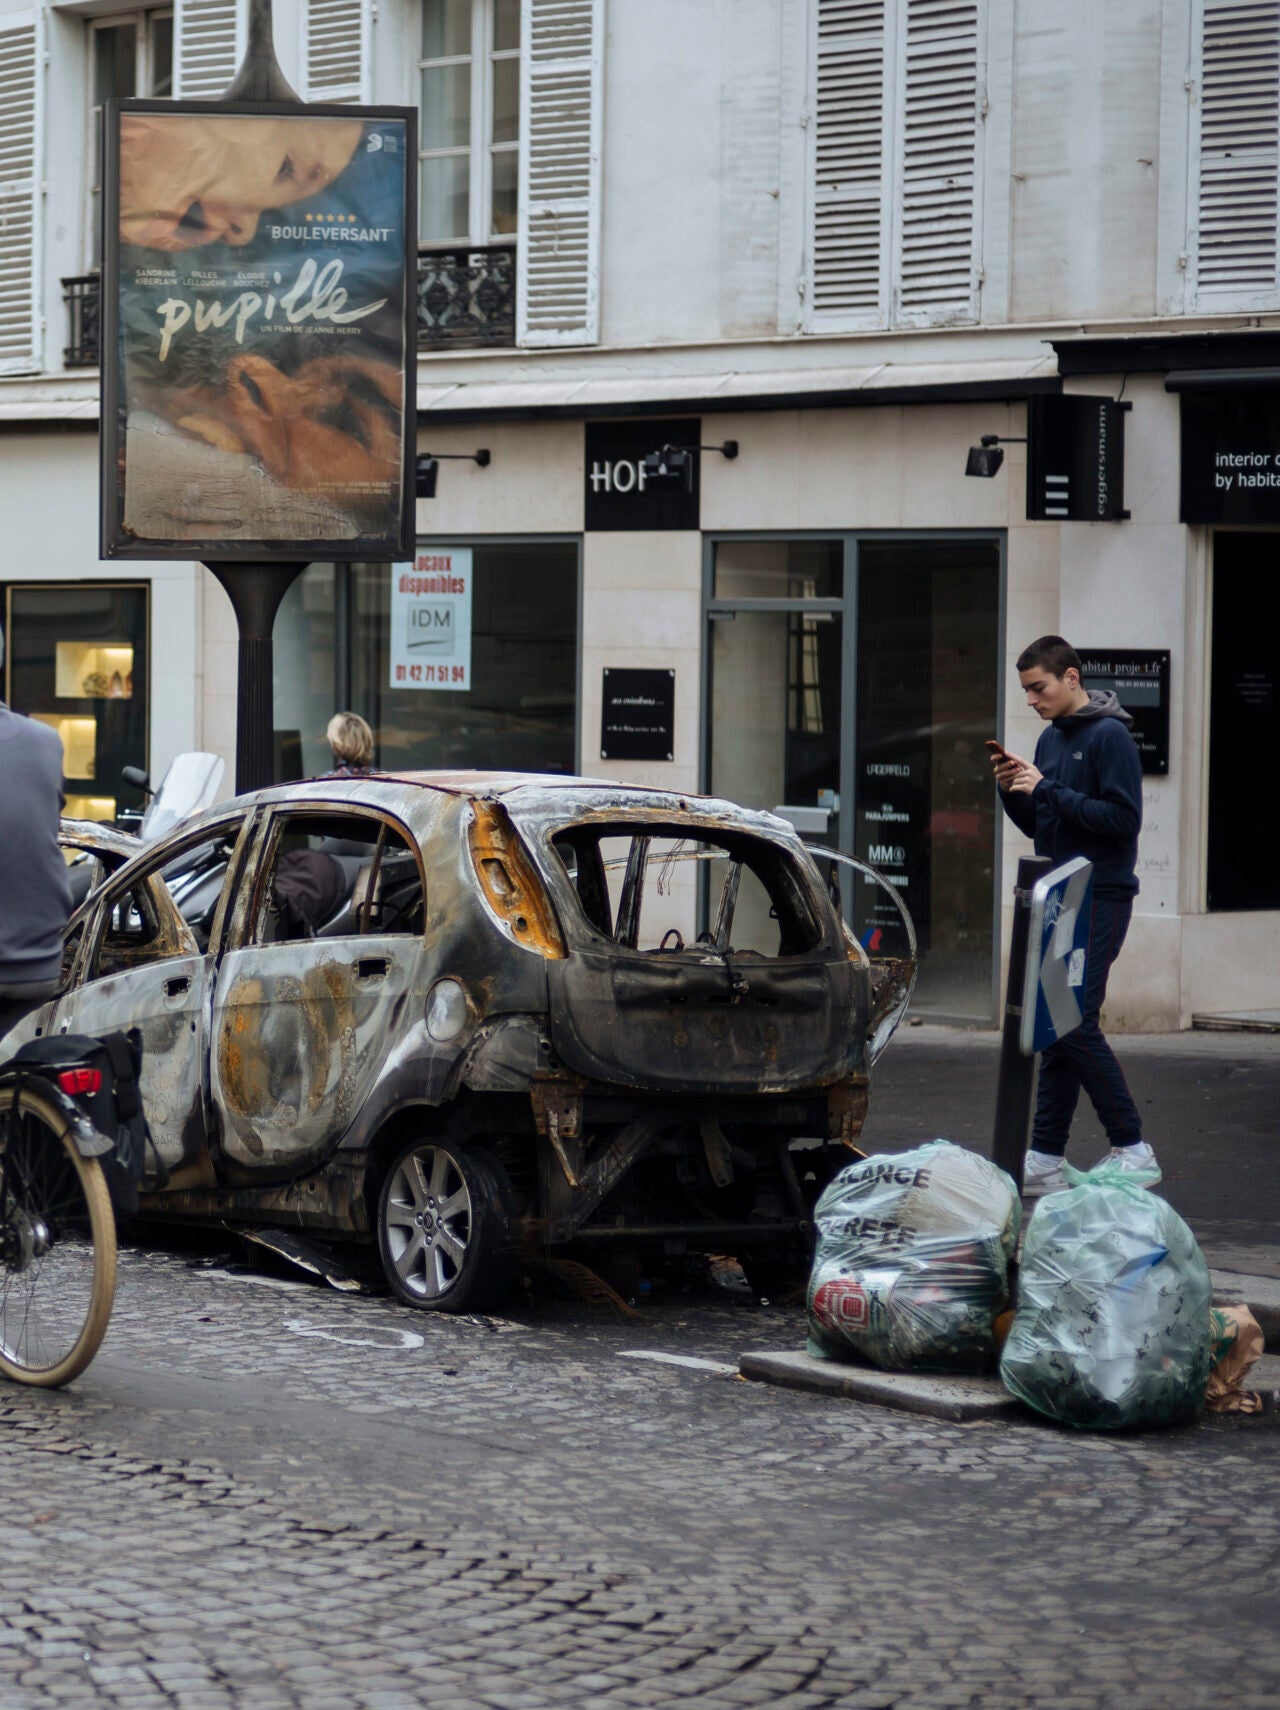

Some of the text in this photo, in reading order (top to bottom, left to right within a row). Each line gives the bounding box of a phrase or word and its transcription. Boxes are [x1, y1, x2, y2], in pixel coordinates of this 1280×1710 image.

[135, 269, 177, 278] SANDRINE
[191, 271, 218, 280] GILLES
[134, 277, 178, 286] KIBERLAIN
[182, 279, 227, 288] LELLOUCHE
[233, 279, 270, 288] BOUCHEZ
[157, 258, 388, 361] pupille
[273, 325, 293, 333] FILM
[293, 326, 304, 334] DE
[304, 326, 335, 335] JEANNE
[336, 327, 362, 335] HERRY
[1098, 405, 1107, 515] eggersmann
[1215, 452, 1271, 467] interior
[1215, 472, 1233, 490] by
[398, 574, 465, 597] disponibles
[412, 609, 451, 628] IDM
[395, 664, 465, 682] 01 42 71 51 94
[1081, 660, 1112, 673] abitat
[865, 811, 910, 822] PARAJUMPERS
